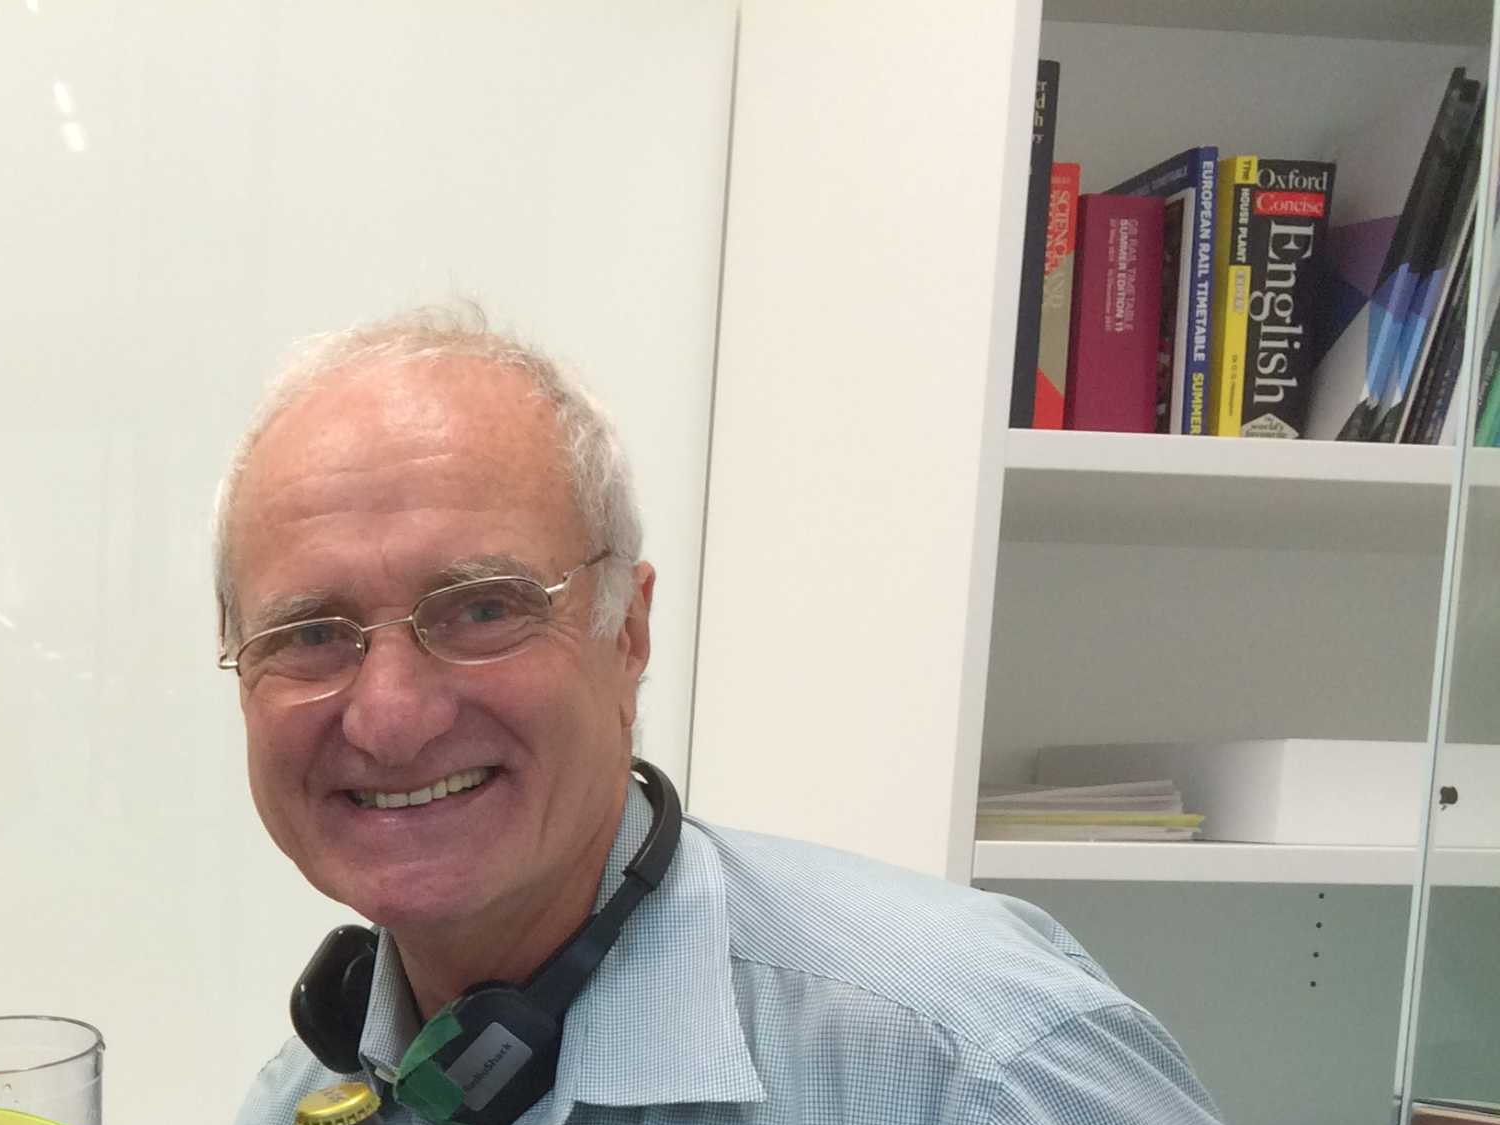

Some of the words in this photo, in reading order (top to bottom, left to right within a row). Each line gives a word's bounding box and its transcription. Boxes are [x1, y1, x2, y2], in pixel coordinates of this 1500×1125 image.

[1200, 160, 1214, 240] EUROPEAN
[1257, 167, 1329, 191] Oxford
[1239, 187, 1250, 225] HOUSE
[1256, 193, 1324, 214] Concise
[1118, 218, 1129, 271] SUMMER
[1198, 243, 1211, 278] RAIL
[1237, 226, 1248, 263] PLANT
[1115, 272, 1127, 318] EDITION
[1249, 220, 1315, 404] English
[1193, 280, 1209, 362] TIMETABLE
[1190, 371, 1205, 434] SUMMER
